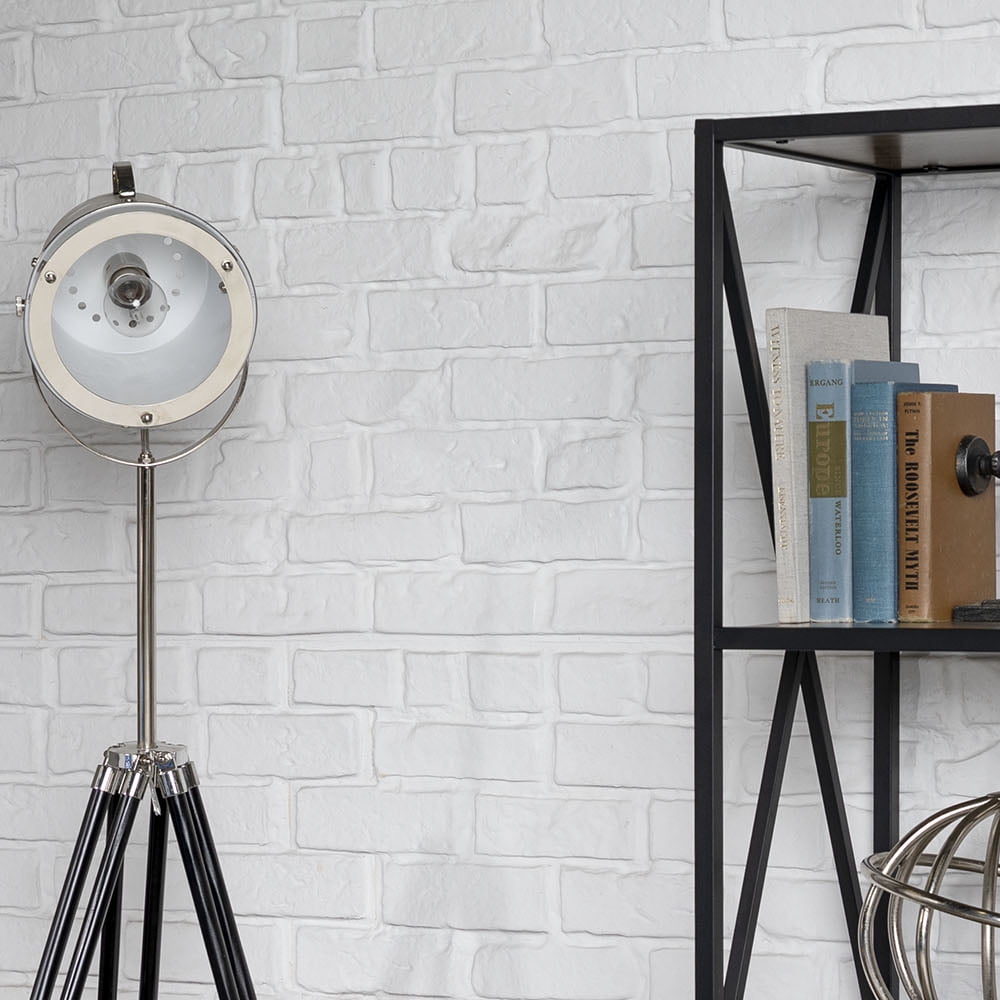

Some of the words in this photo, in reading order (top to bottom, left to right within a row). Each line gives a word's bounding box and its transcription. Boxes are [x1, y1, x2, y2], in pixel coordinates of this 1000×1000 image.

[809, 378, 844, 387] ERGANG
[904, 429, 919, 456] The
[904, 462, 920, 544] ROOSEVELT
[834, 500, 843, 556] WATERLOO
[904, 550, 919, 591] MYTH
